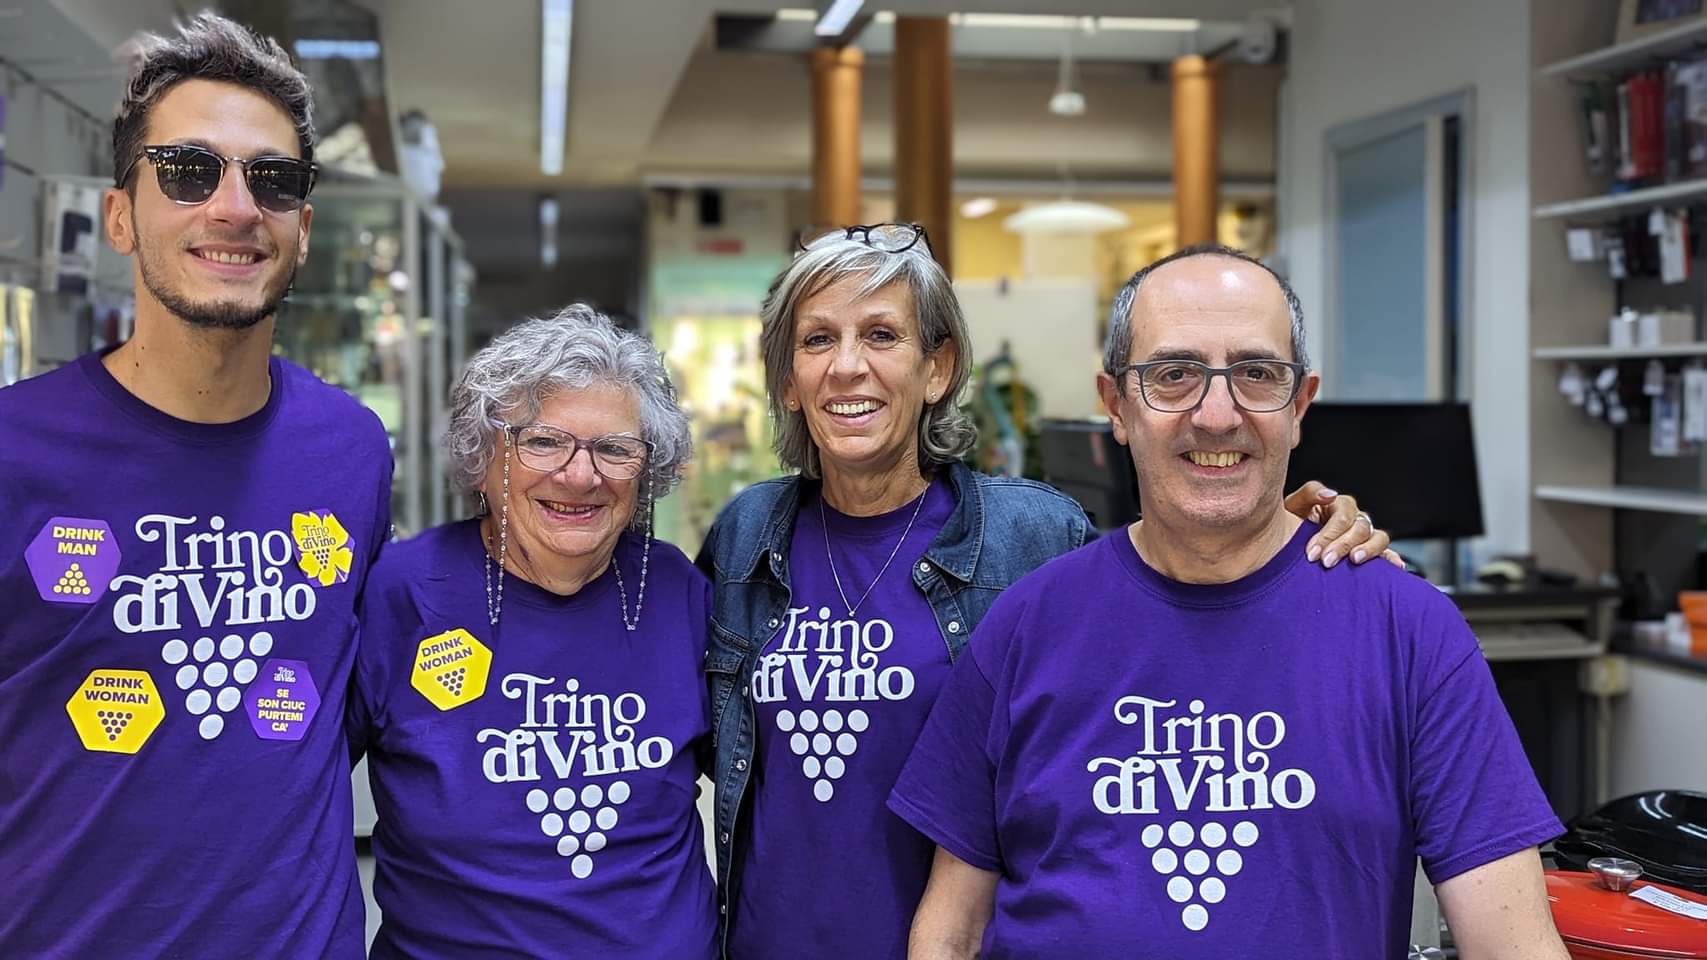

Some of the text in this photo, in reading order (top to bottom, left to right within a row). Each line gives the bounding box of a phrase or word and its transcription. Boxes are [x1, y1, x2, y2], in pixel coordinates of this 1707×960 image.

[53, 526, 105, 541] DRINK
[301, 524, 330, 538] Trino
[58, 542, 97, 556] MAN
[135, 514, 292, 586] Trino
[421, 636, 464, 657] DRINK
[419, 647, 473, 671] WOMAN
[93, 677, 144, 689] DRINK
[85, 690, 149, 704] WOMAN
[276, 688, 290, 698] SE
[257, 698, 306, 711] SON CIUC
[501, 673, 646, 743] Trino
[258, 710, 303, 722] PURTEMI
[1114, 695, 1286, 773] Trino
